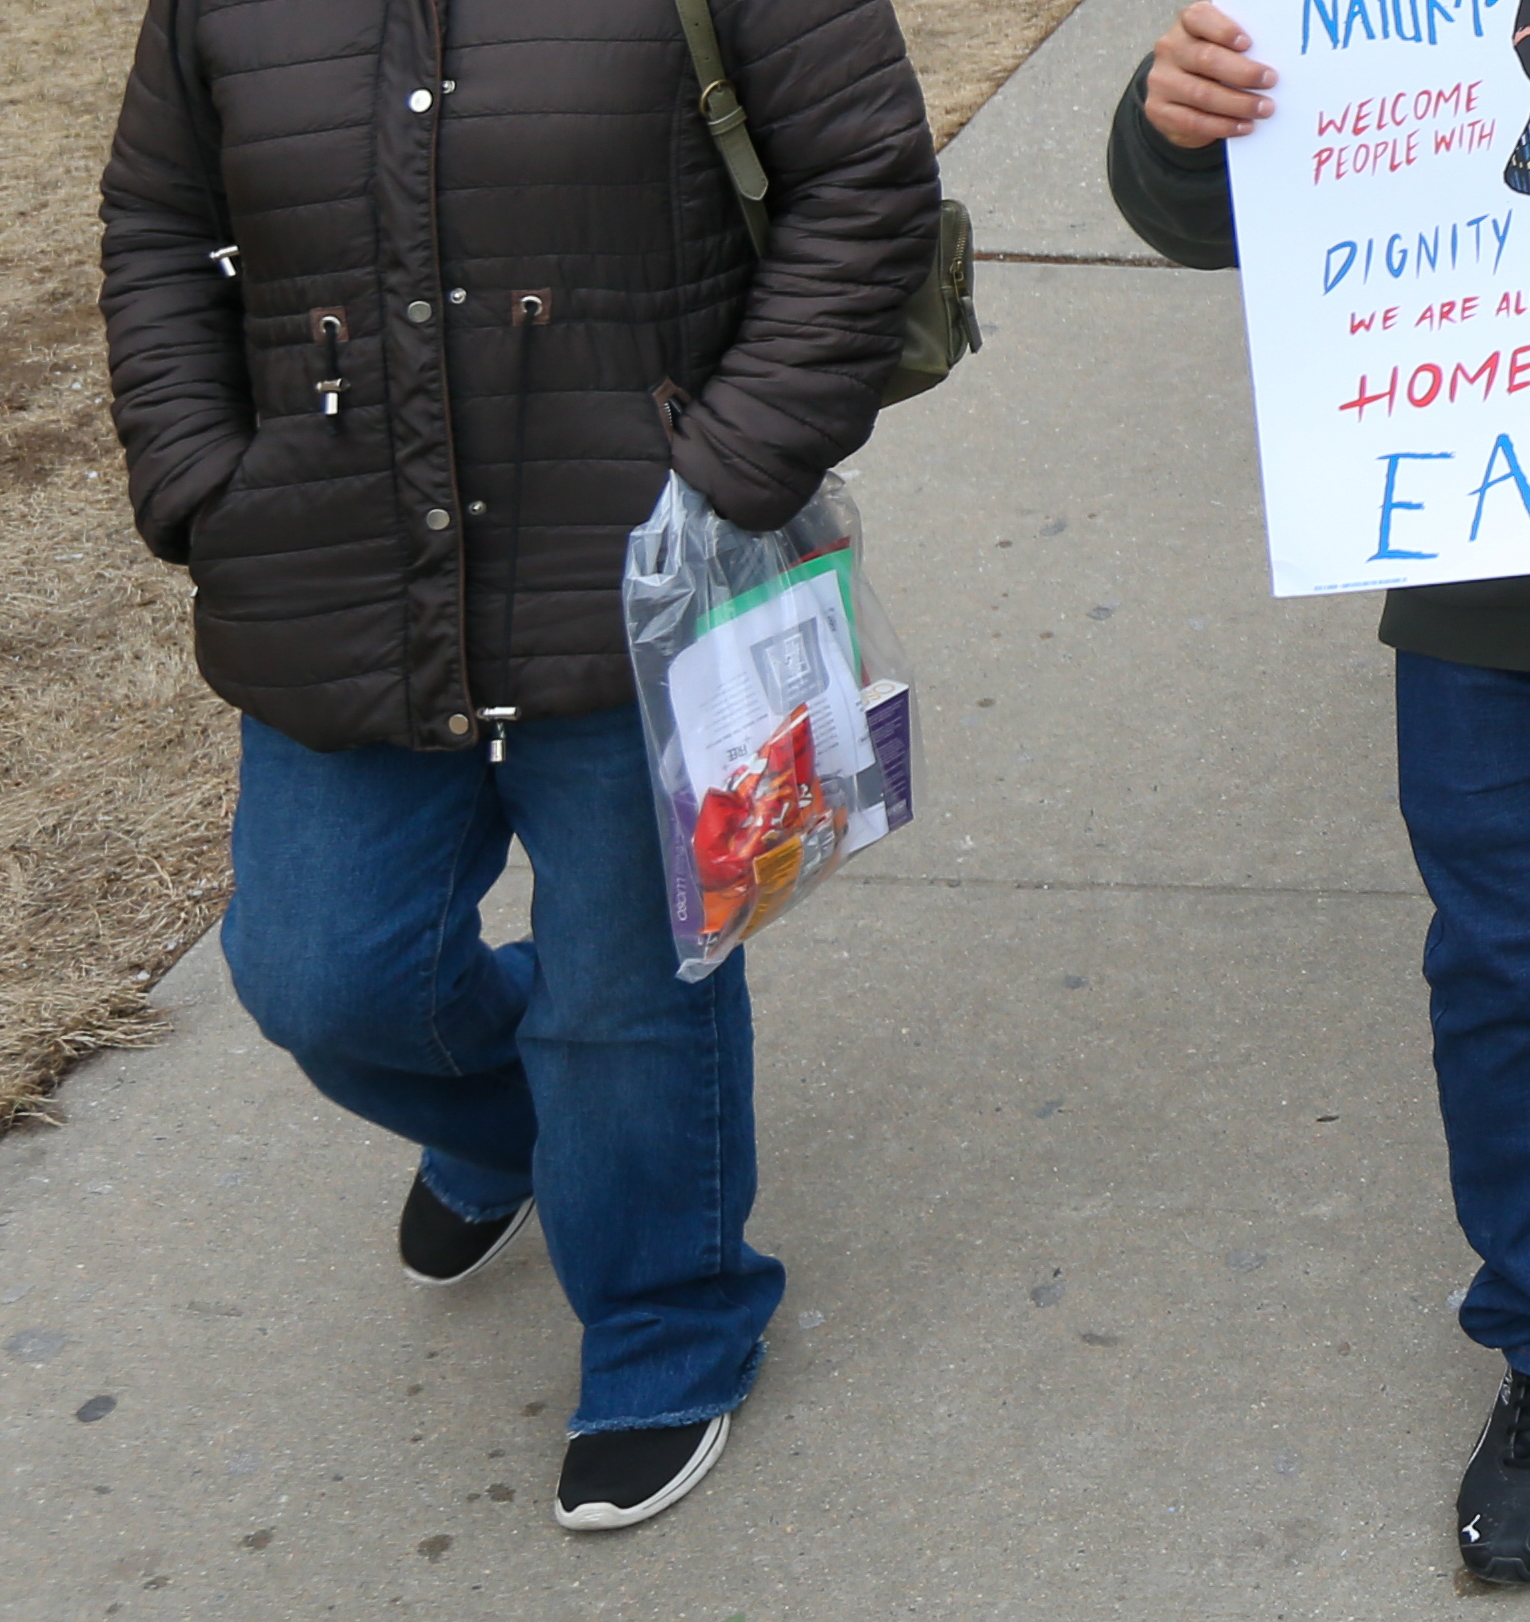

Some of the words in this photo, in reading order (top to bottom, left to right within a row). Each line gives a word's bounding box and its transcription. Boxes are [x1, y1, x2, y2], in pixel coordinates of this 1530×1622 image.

[1317, 79, 1483, 137] WELCOME
[1312, 129, 1421, 186] PEOPLE
[1433, 119, 1497, 154] WITH
[1322, 208, 1514, 296] DIGNITY
[1349, 306, 1399, 336] WE
[1414, 295, 1481, 331] ARE
[726, 745, 748, 762] FREE
